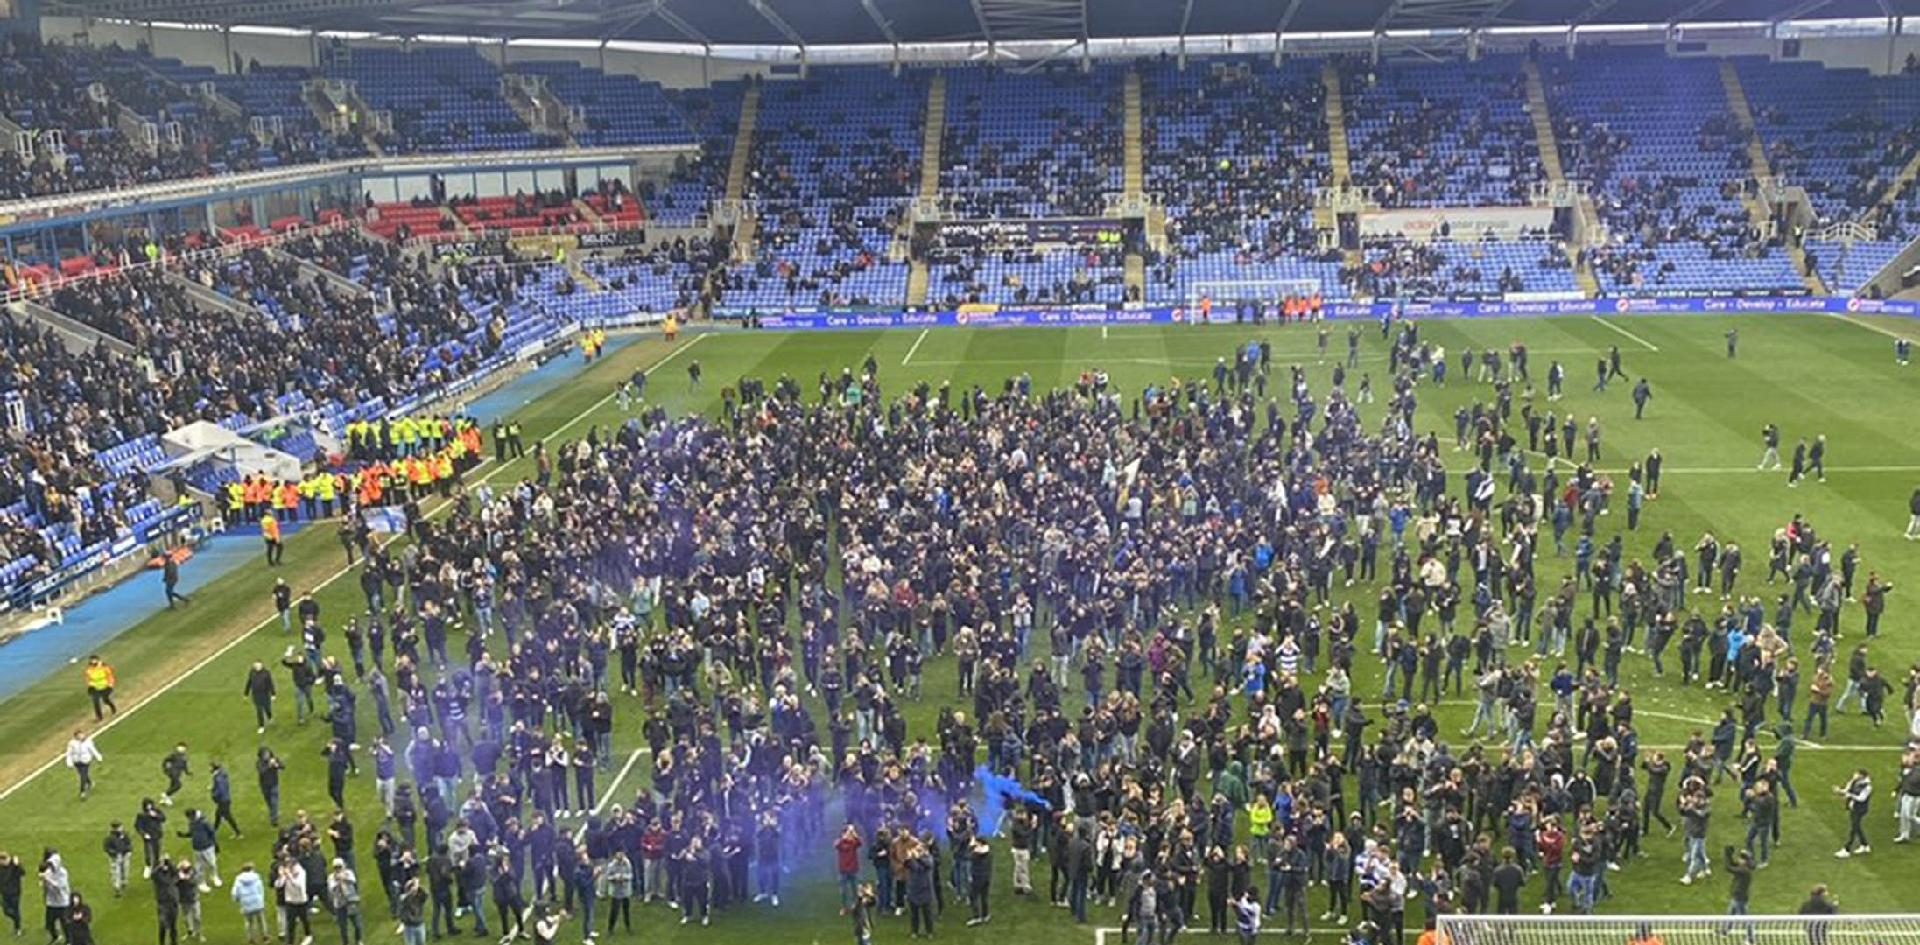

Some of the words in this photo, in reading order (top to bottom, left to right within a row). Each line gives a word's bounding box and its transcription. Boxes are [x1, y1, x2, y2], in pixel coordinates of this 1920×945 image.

[941, 224, 979, 237] energy
[981, 222, 1028, 234] efficient
[1477, 302, 1501, 314] Care
[1509, 301, 1548, 314] Develop
[1557, 300, 1596, 312] Educate
[1703, 299, 1726, 311] Care
[1736, 298, 1775, 311] Develop
[1785, 297, 1826, 309] Educate
[826, 315, 848, 327] Care
[857, 314, 893, 327] Develop
[902, 313, 938, 324] Educate
[1039, 311, 1060, 322] Care
[1070, 311, 1107, 323] Develop
[1116, 311, 1152, 321] Educate
